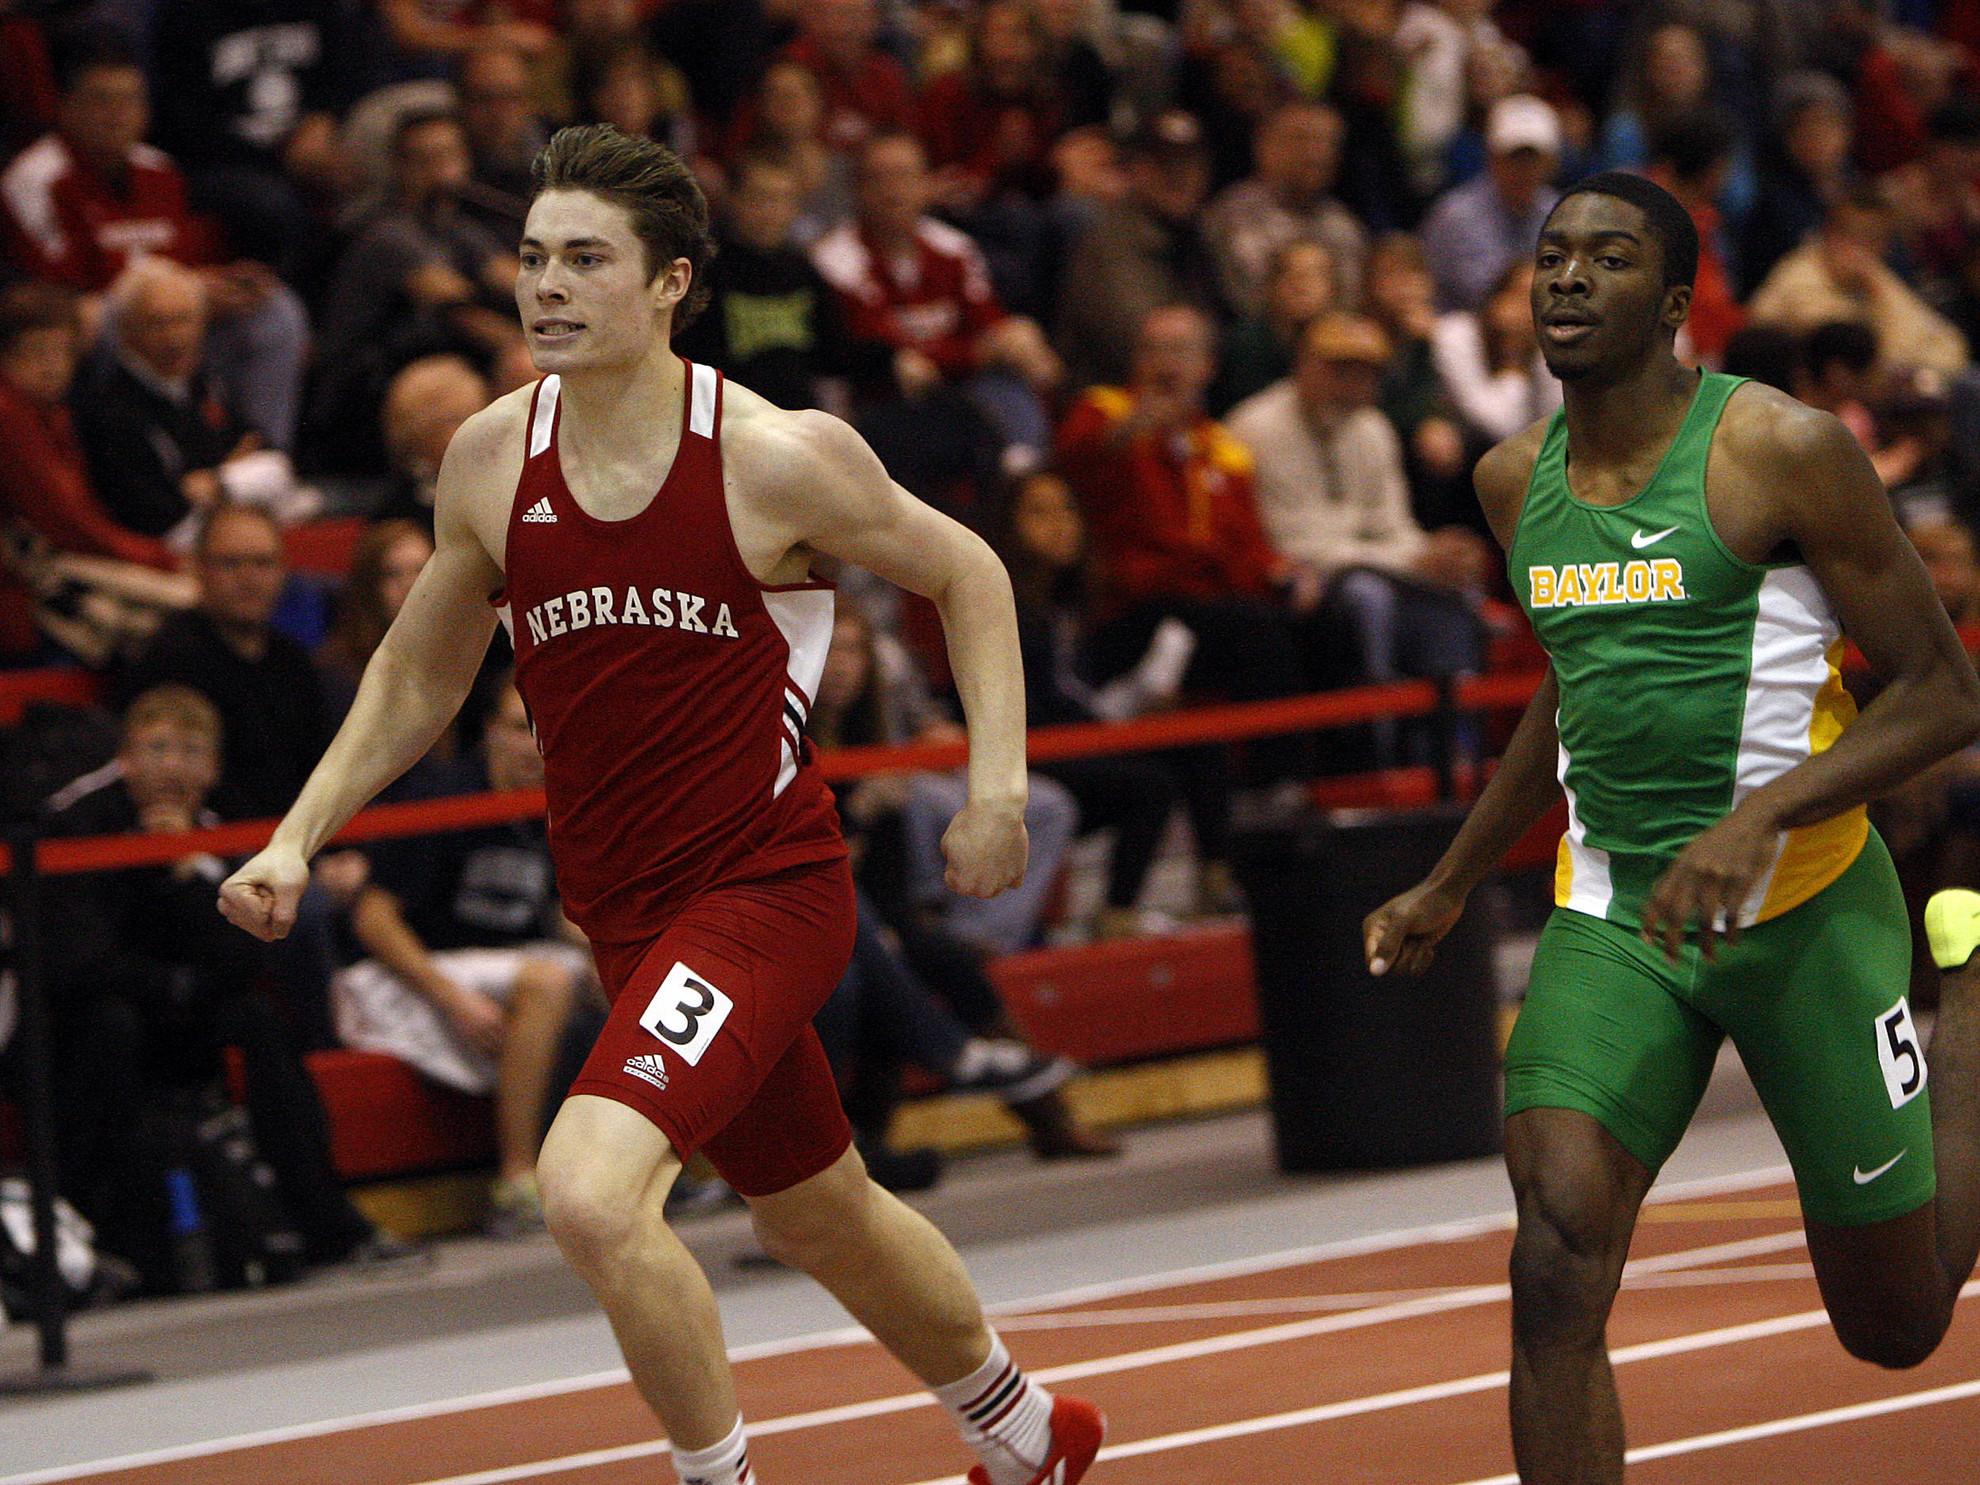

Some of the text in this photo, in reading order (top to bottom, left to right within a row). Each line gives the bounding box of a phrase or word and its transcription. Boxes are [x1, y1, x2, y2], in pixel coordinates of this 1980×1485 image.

[522, 513, 558, 522] adidas
[1529, 558, 1686, 608] BAYLOR
[525, 586, 740, 646] NEBRASKA
[654, 977, 715, 1046] 3
[1884, 1008, 1921, 1096] 5
